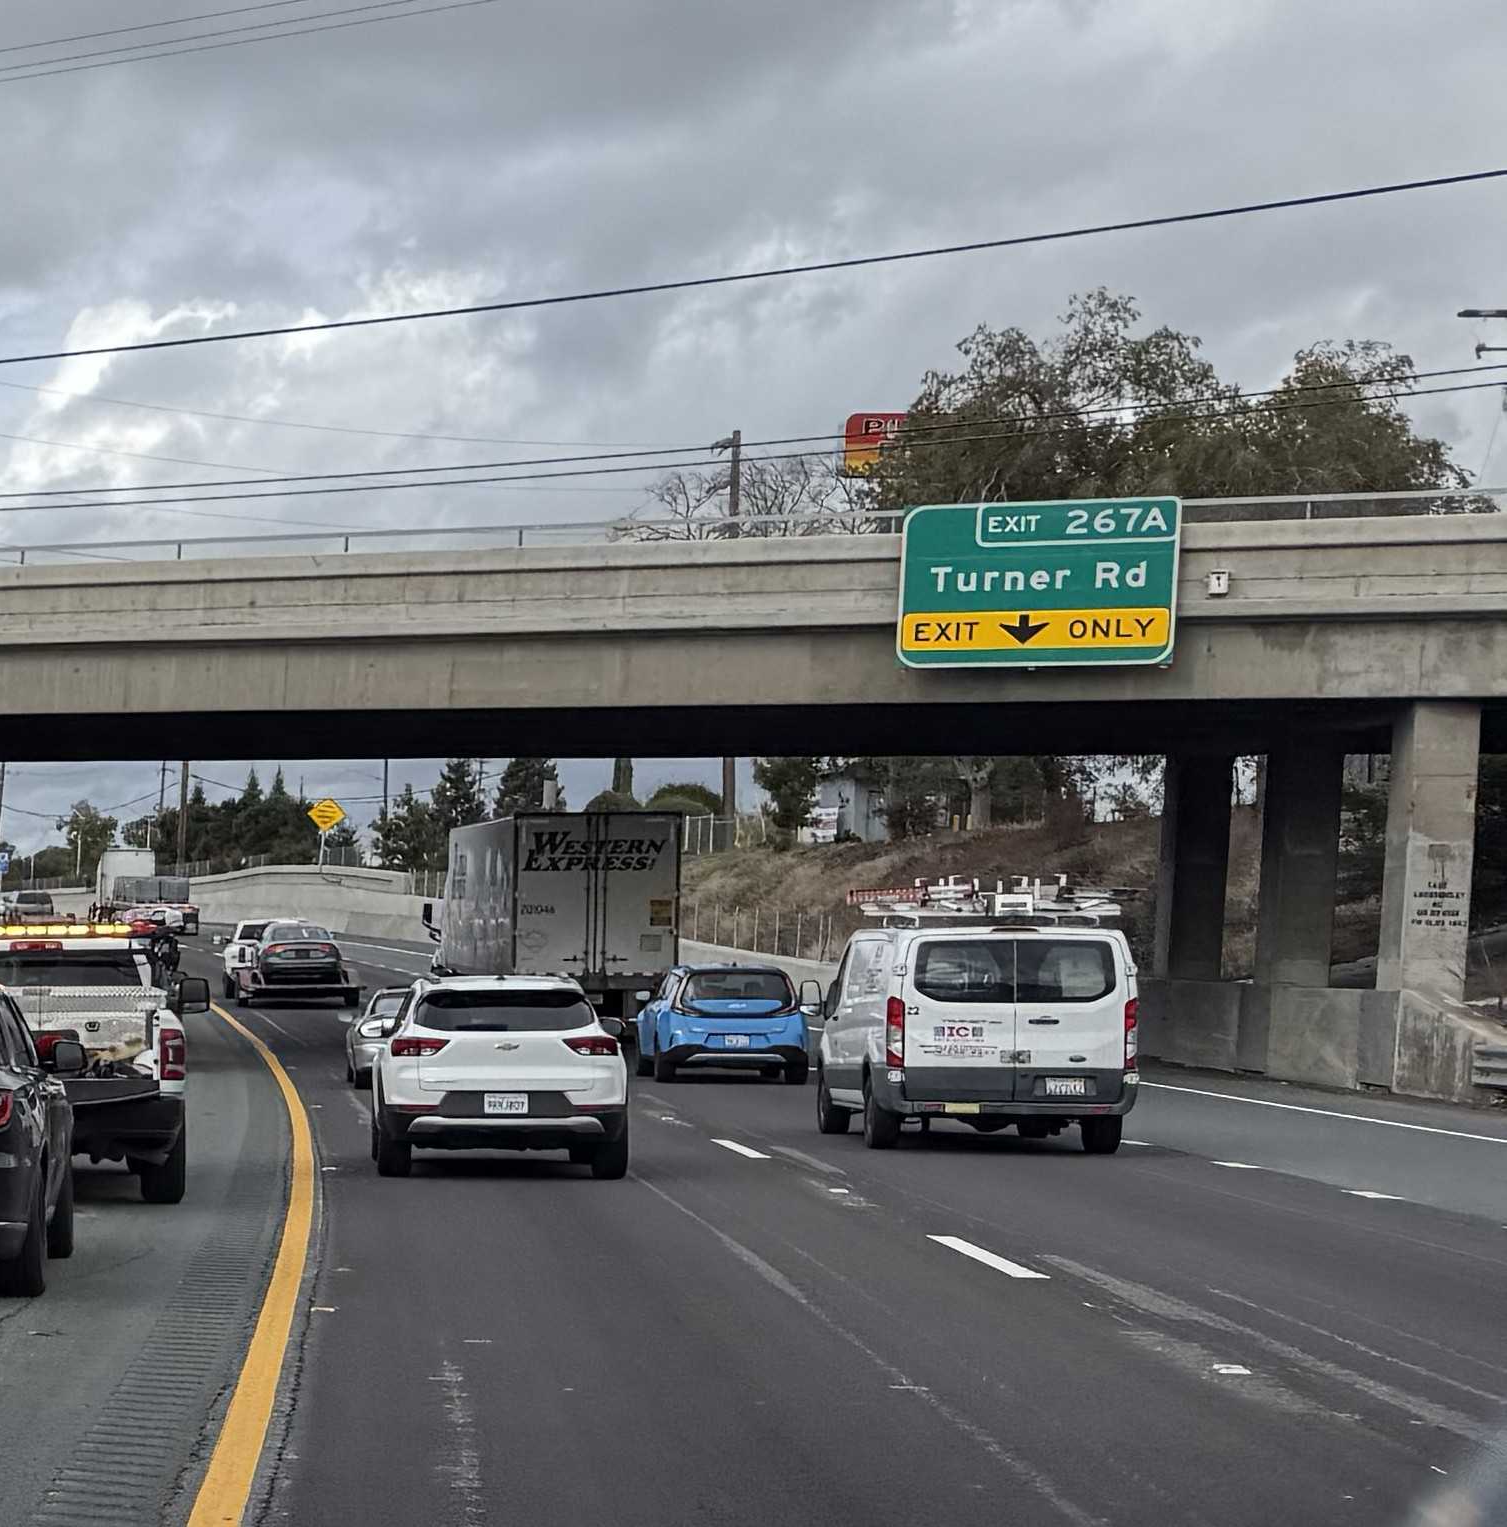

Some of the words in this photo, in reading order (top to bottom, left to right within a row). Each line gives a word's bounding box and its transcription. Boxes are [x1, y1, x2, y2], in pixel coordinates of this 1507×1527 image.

[988, 514, 1041, 533] EXIT
[1066, 507, 1167, 534] 267A
[930, 566, 1071, 592] Turner
[1095, 560, 1147, 588] Rd
[914, 621, 980, 642] EXIT
[1069, 617, 1155, 639] ONLY
[532, 831, 668, 855] WESTERN
[522, 849, 650, 872] EXPRESS
